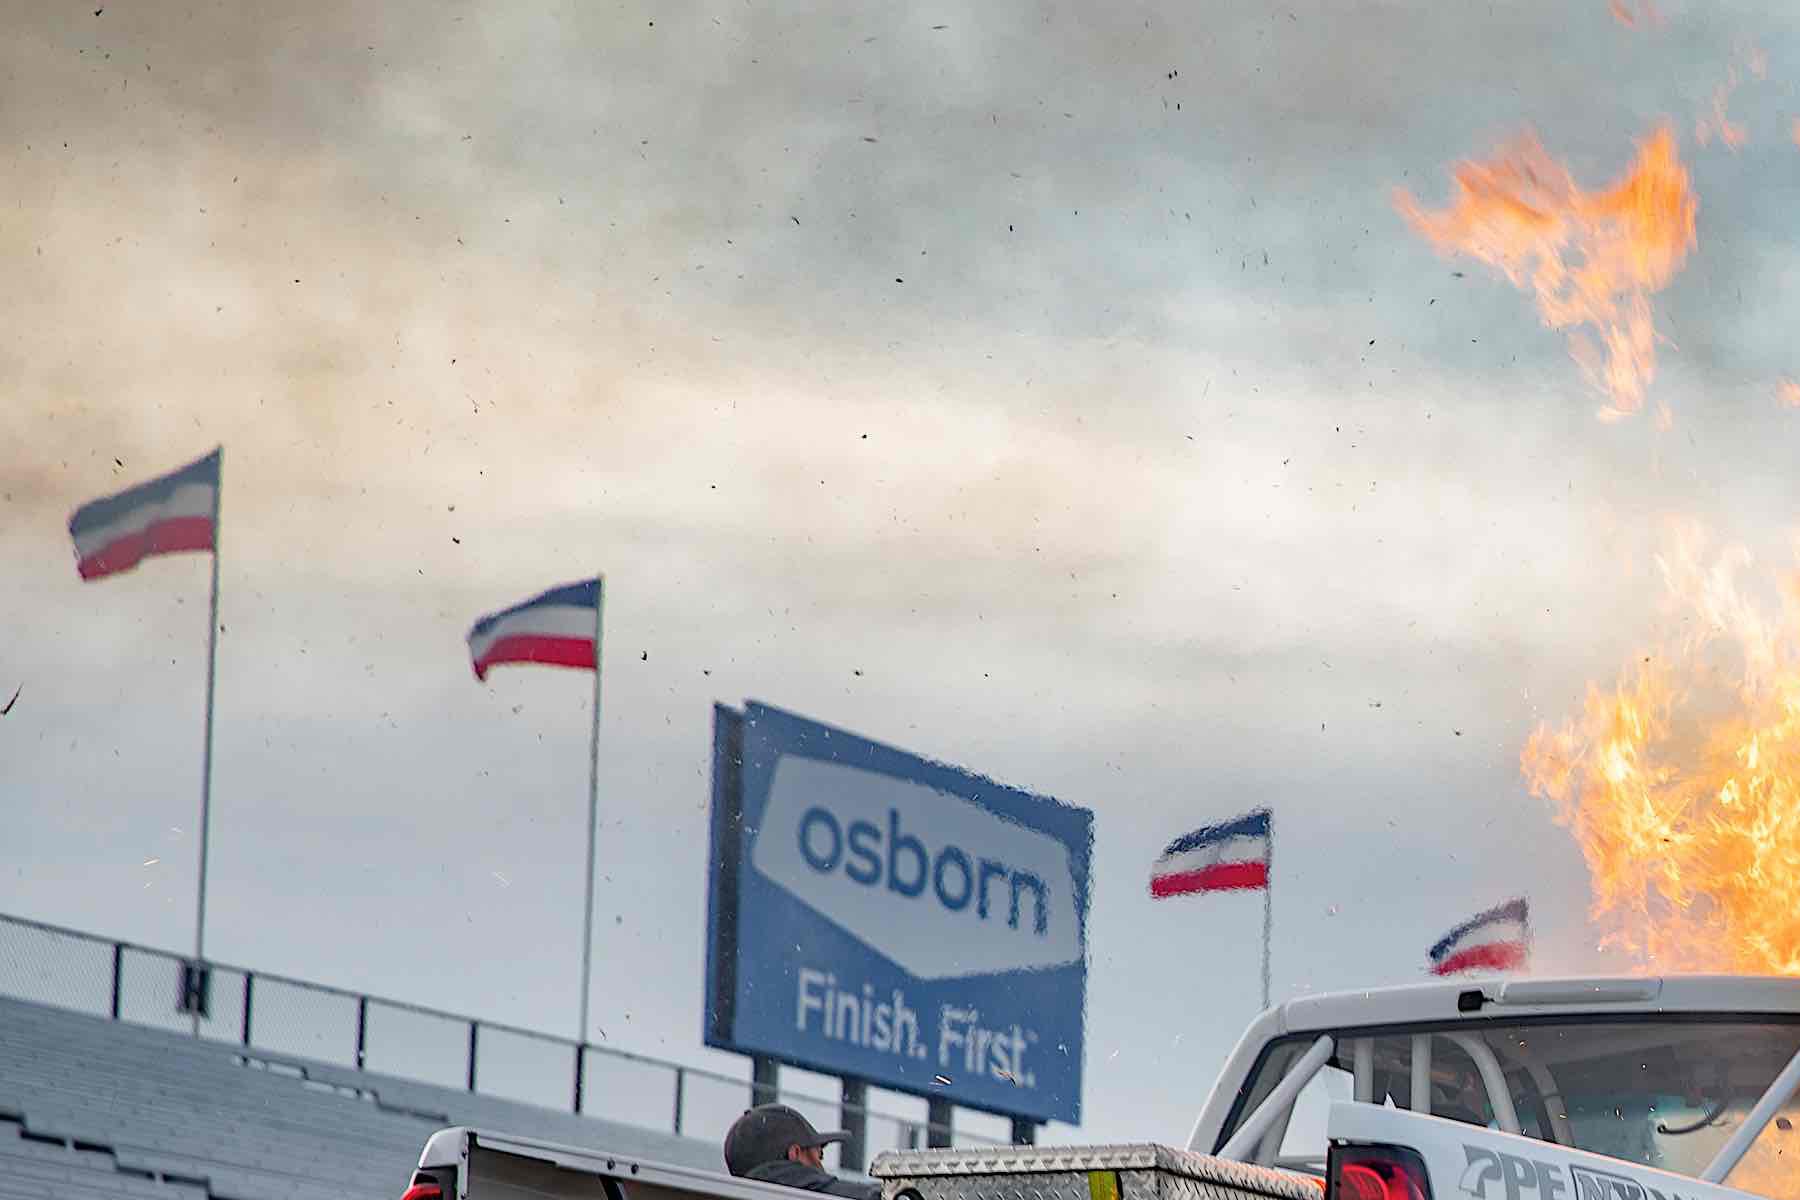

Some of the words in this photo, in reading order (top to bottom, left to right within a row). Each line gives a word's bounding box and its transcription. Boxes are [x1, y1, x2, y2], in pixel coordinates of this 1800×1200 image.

[798, 806, 1049, 936] osborn
[797, 966, 928, 1060] Finish.
[938, 1003, 1036, 1088] First.
